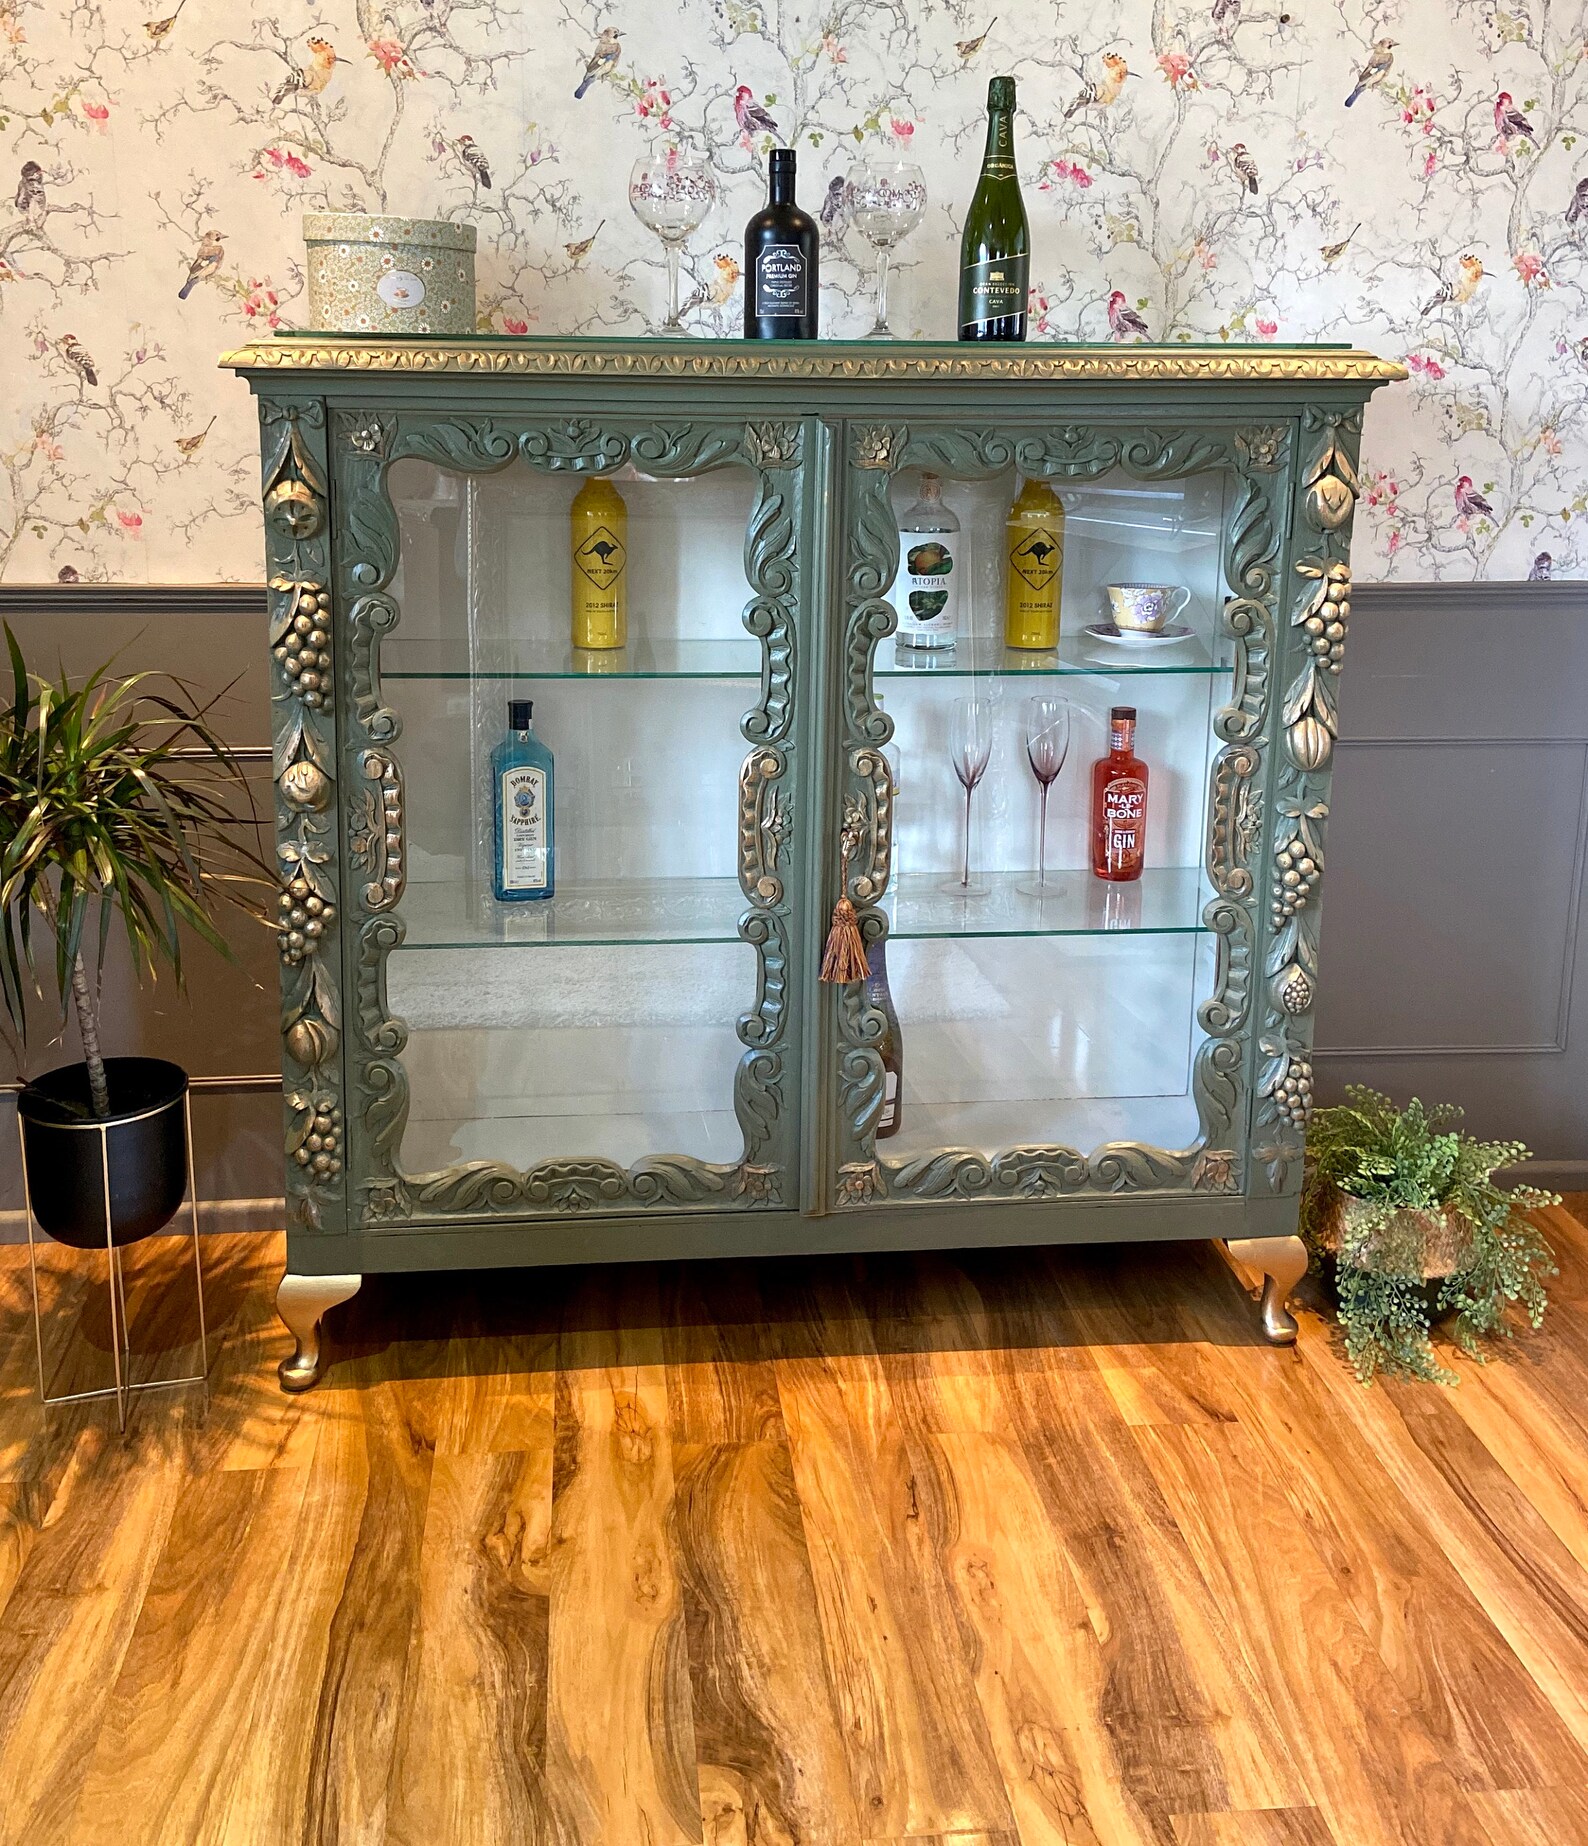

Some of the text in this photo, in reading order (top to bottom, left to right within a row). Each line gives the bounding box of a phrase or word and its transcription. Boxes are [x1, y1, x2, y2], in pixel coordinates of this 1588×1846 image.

[999, 115, 1008, 147] CAVA
[761, 263, 802, 273] PORTLAND
[972, 286, 1021, 294] CONTEVEDO
[911, 577, 946, 585] ATOPIA
[510, 775, 539, 789] BOMBAY
[1107, 792, 1144, 804] MARY
[1106, 808, 1143, 819] BONE
[1113, 833, 1136, 849] GIN
